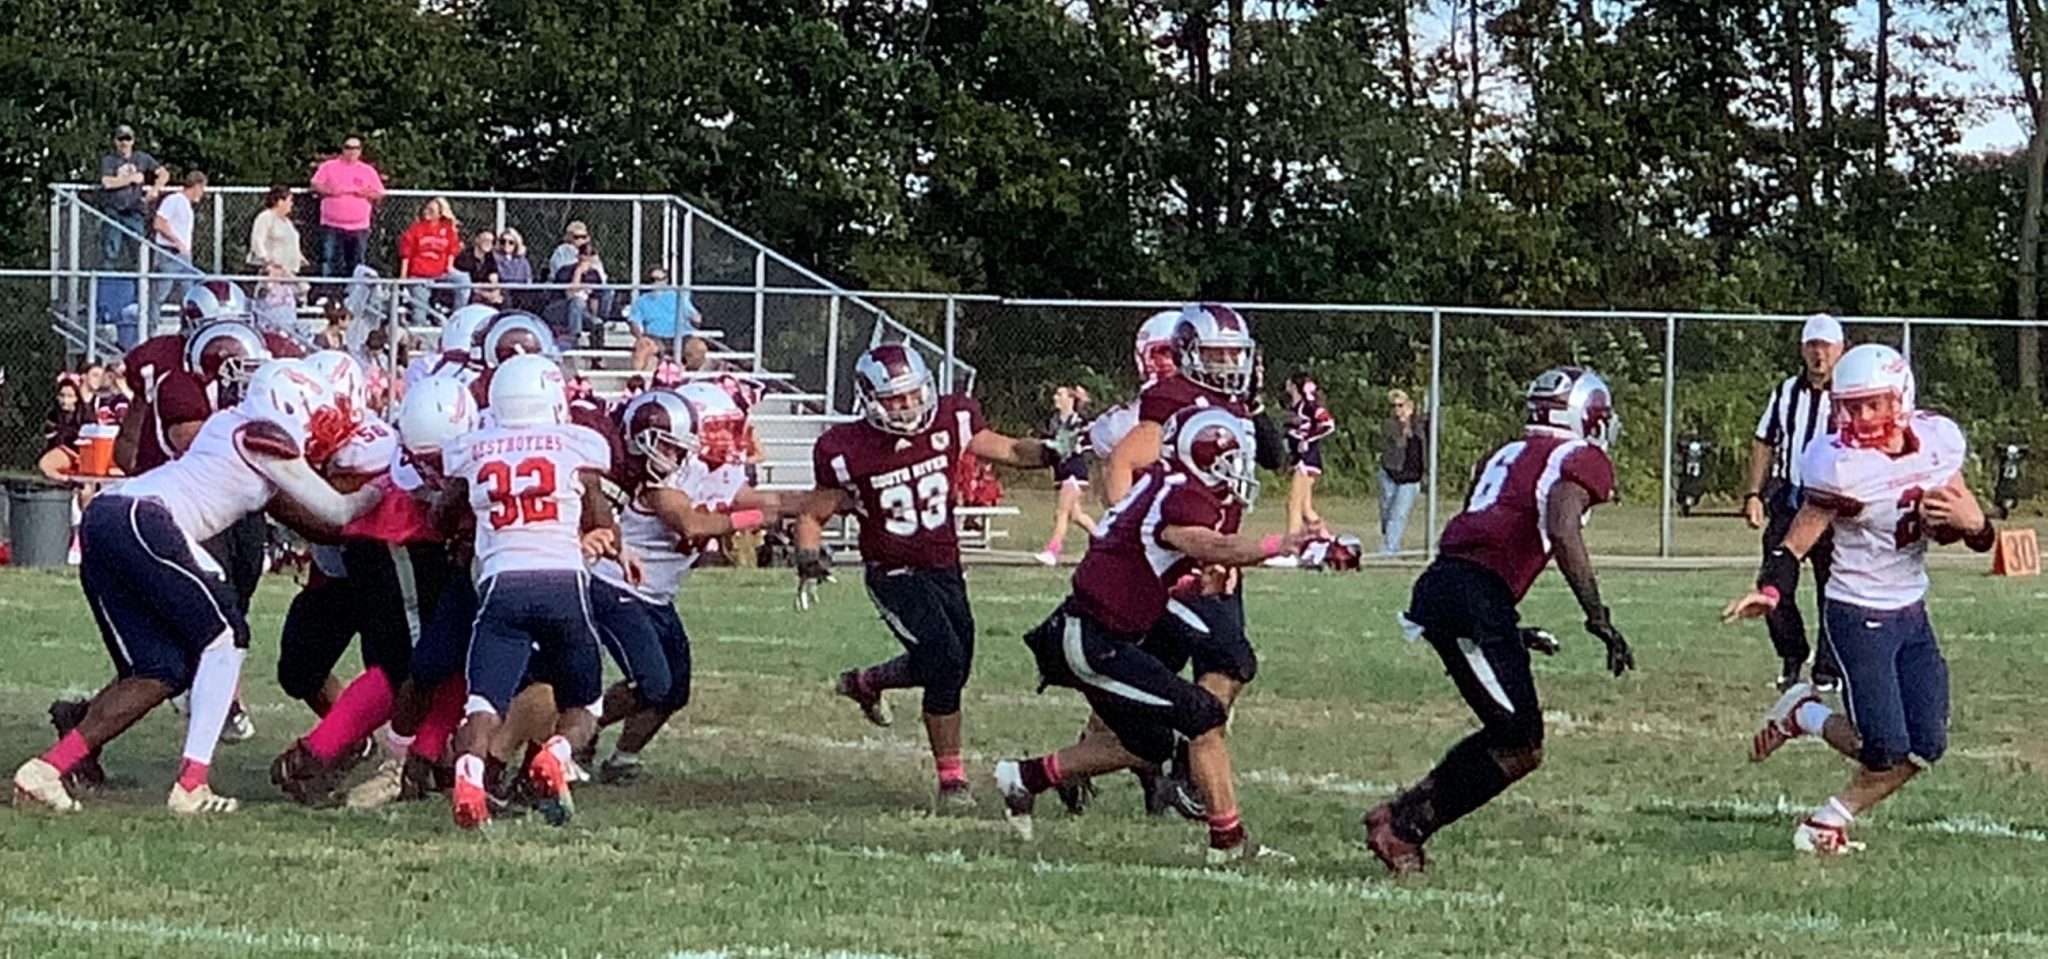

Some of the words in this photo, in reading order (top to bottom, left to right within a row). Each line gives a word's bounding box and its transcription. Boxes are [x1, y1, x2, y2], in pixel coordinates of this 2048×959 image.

[477, 456, 559, 531] 32
[870, 466, 911, 490] SOUTH
[880, 472, 949, 536] 33
[1467, 441, 1527, 512] 6
[2005, 534, 2036, 572] 30
